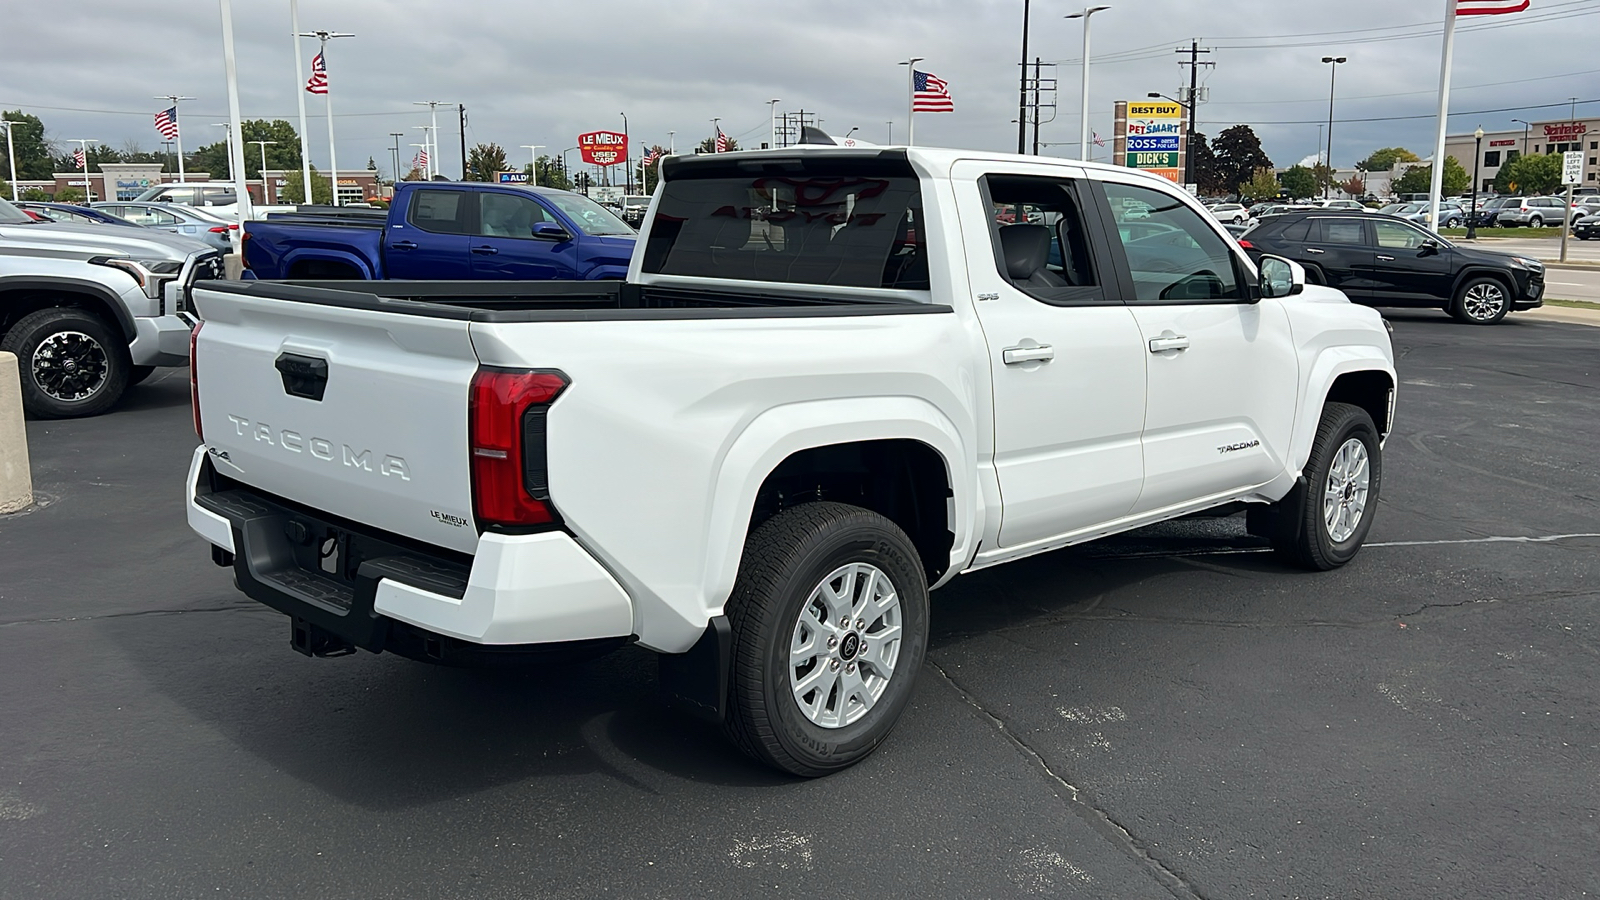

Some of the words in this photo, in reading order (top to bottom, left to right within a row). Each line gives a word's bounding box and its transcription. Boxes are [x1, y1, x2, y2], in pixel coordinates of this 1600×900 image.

[583, 136, 594, 145] LE
[595, 133, 623, 145] MIEUX
[1128, 139, 1157, 149] ROSS
[1137, 153, 1169, 164] DICK'S
[228, 413, 411, 481] TACOMA
[1217, 439, 1260, 455] TACOMA
[430, 509, 440, 519] LE
[441, 512, 469, 527] MIEUX
